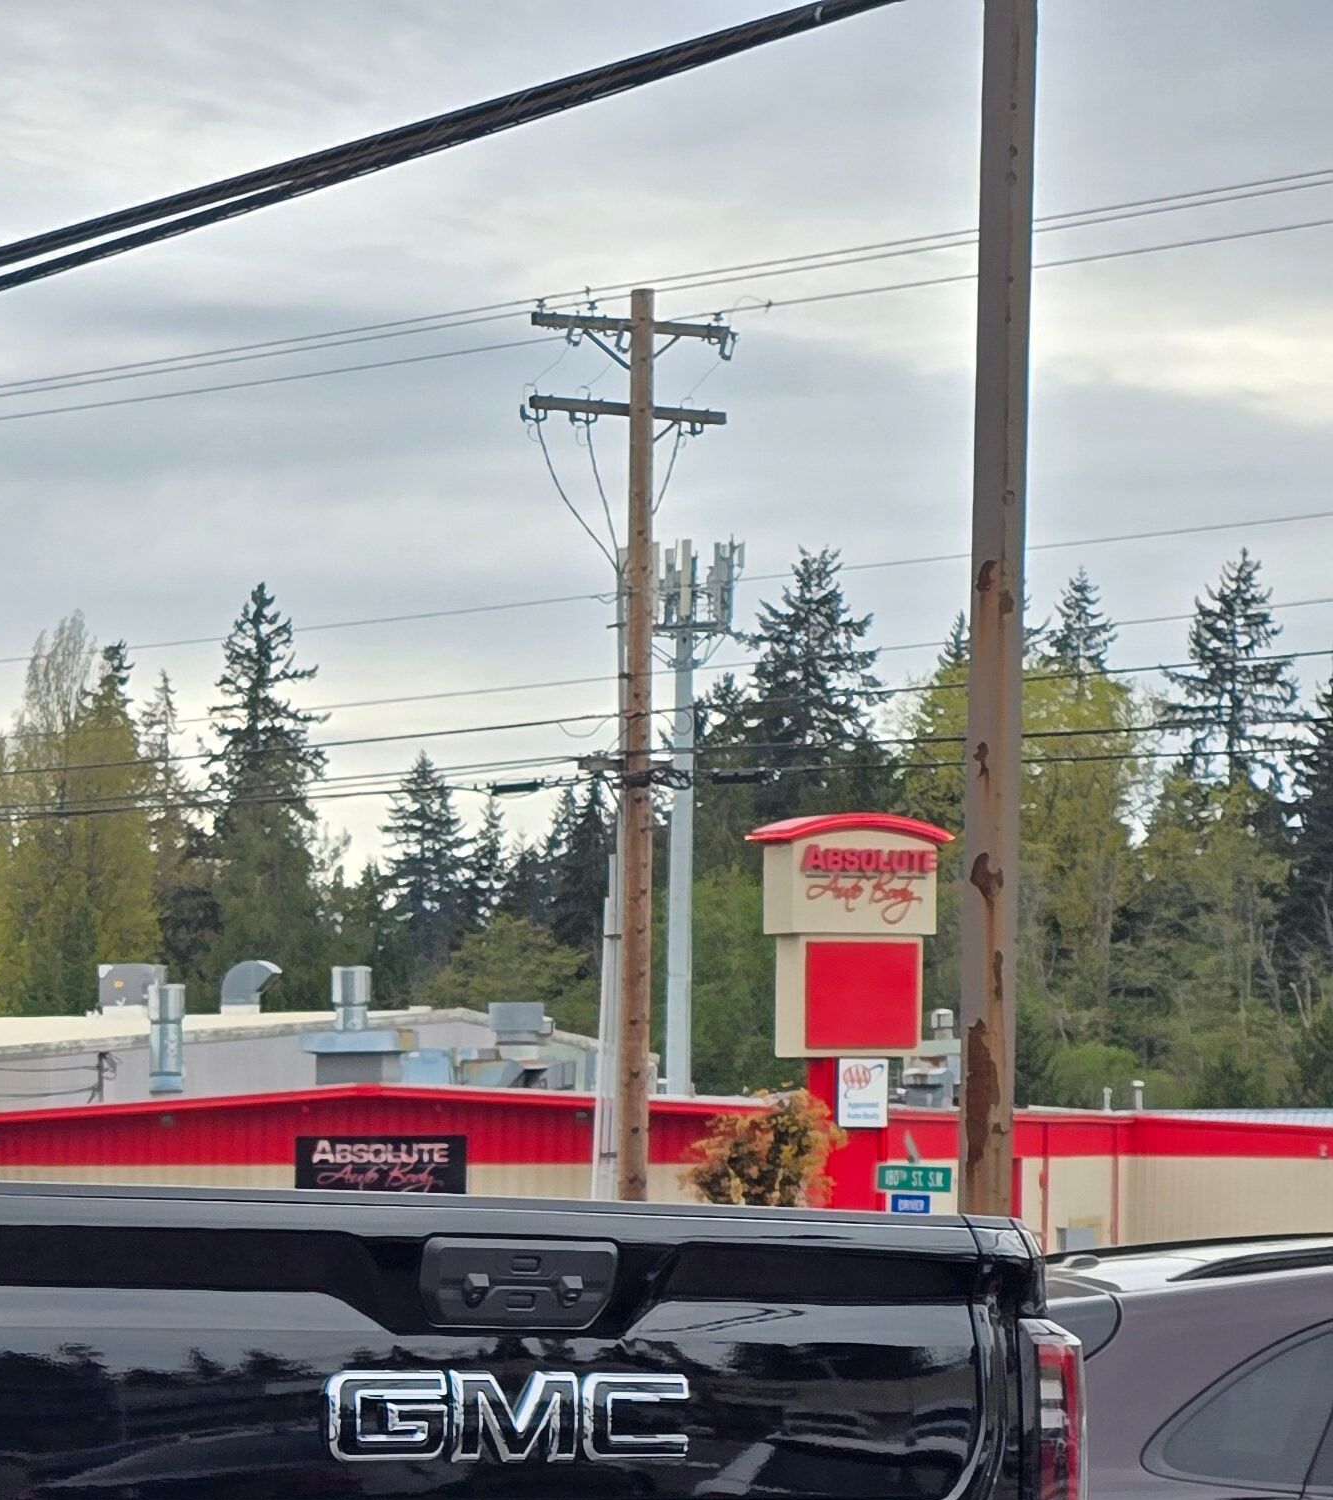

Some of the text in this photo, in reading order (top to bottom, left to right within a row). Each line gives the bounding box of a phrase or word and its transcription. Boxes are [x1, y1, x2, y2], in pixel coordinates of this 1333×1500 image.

[801, 844, 937, 872] ABSOLUTE
[312, 1139, 449, 1164] ABSOLUTE
[316, 1164, 444, 1192] Auto Body
[323, 1370, 689, 1464] GMC
